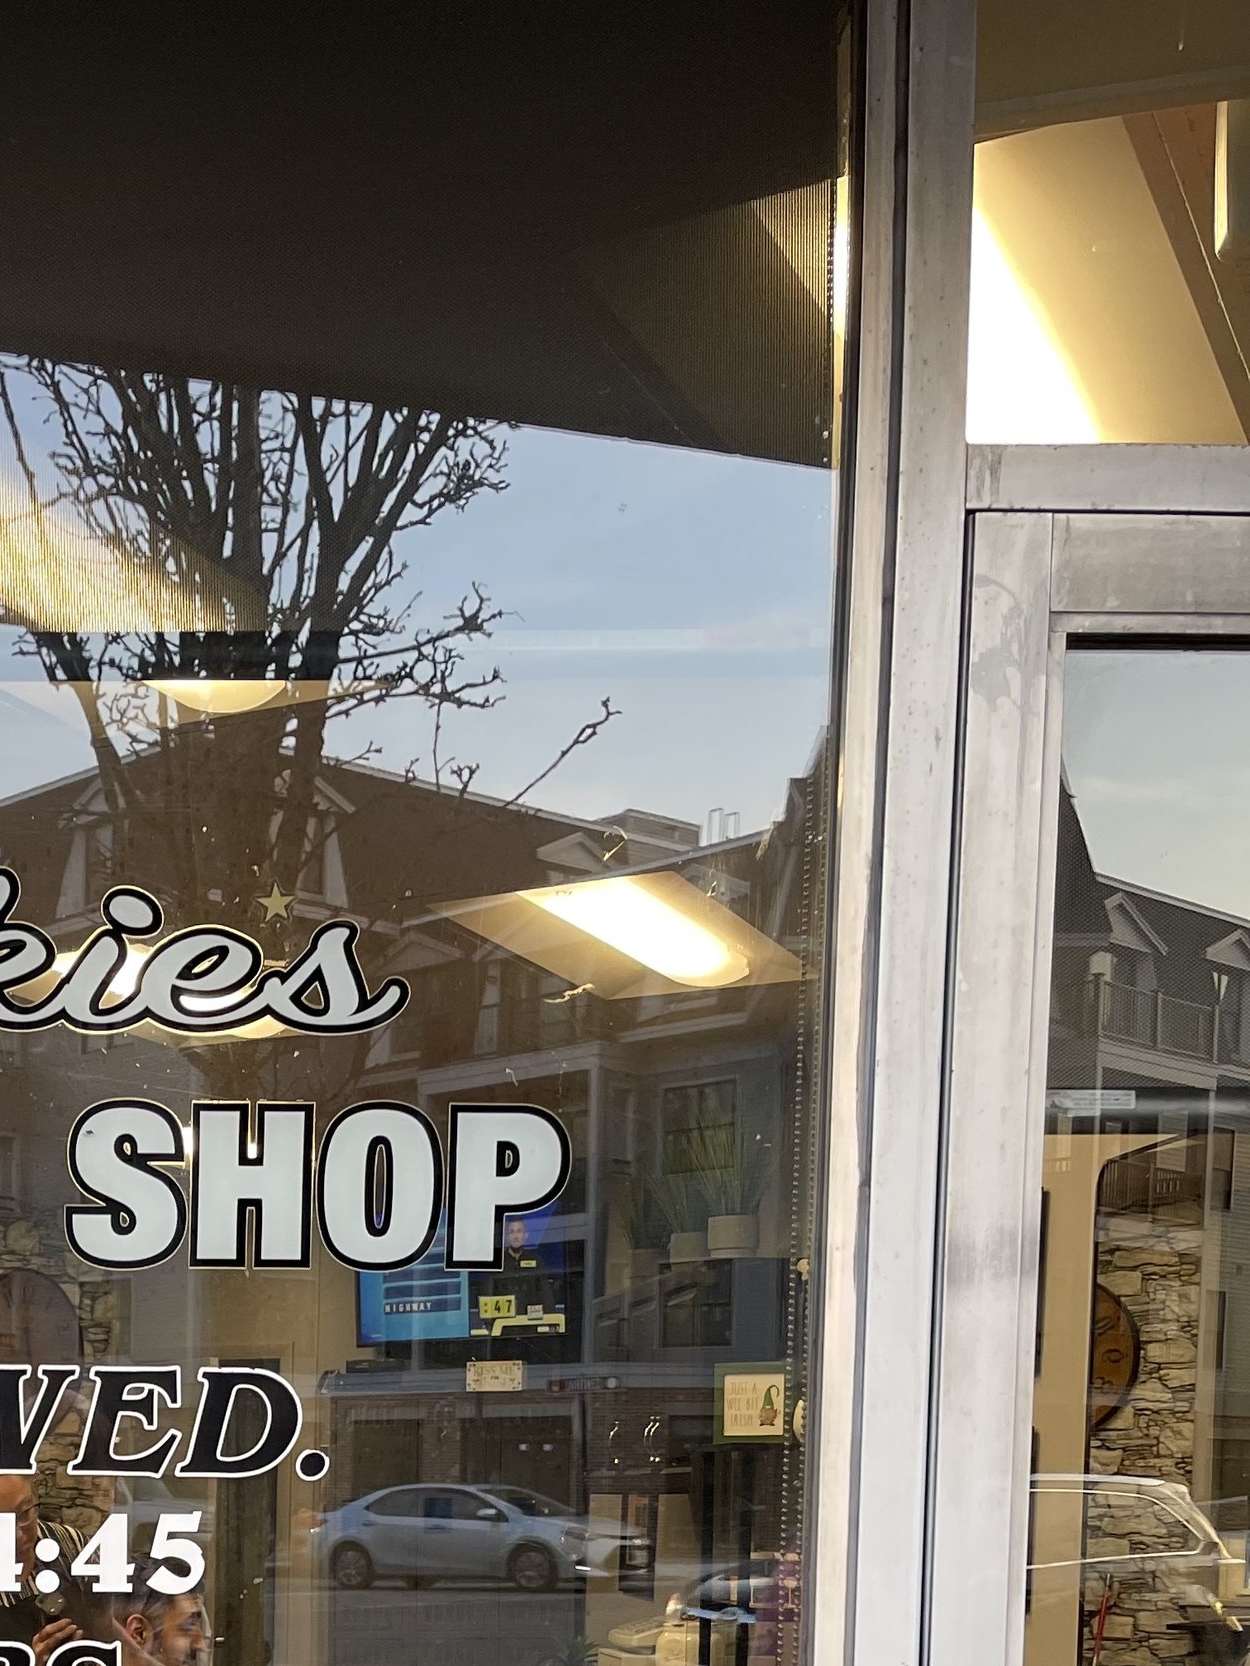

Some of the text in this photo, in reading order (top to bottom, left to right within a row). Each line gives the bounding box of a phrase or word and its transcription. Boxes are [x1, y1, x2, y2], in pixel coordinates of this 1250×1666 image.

[63, 1098, 572, 1272] SHOP
[384, 1301, 432, 1315] HIGHWAY
[728, 1381, 748, 1396] JUST
[730, 1413, 754, 1427] IRISH
